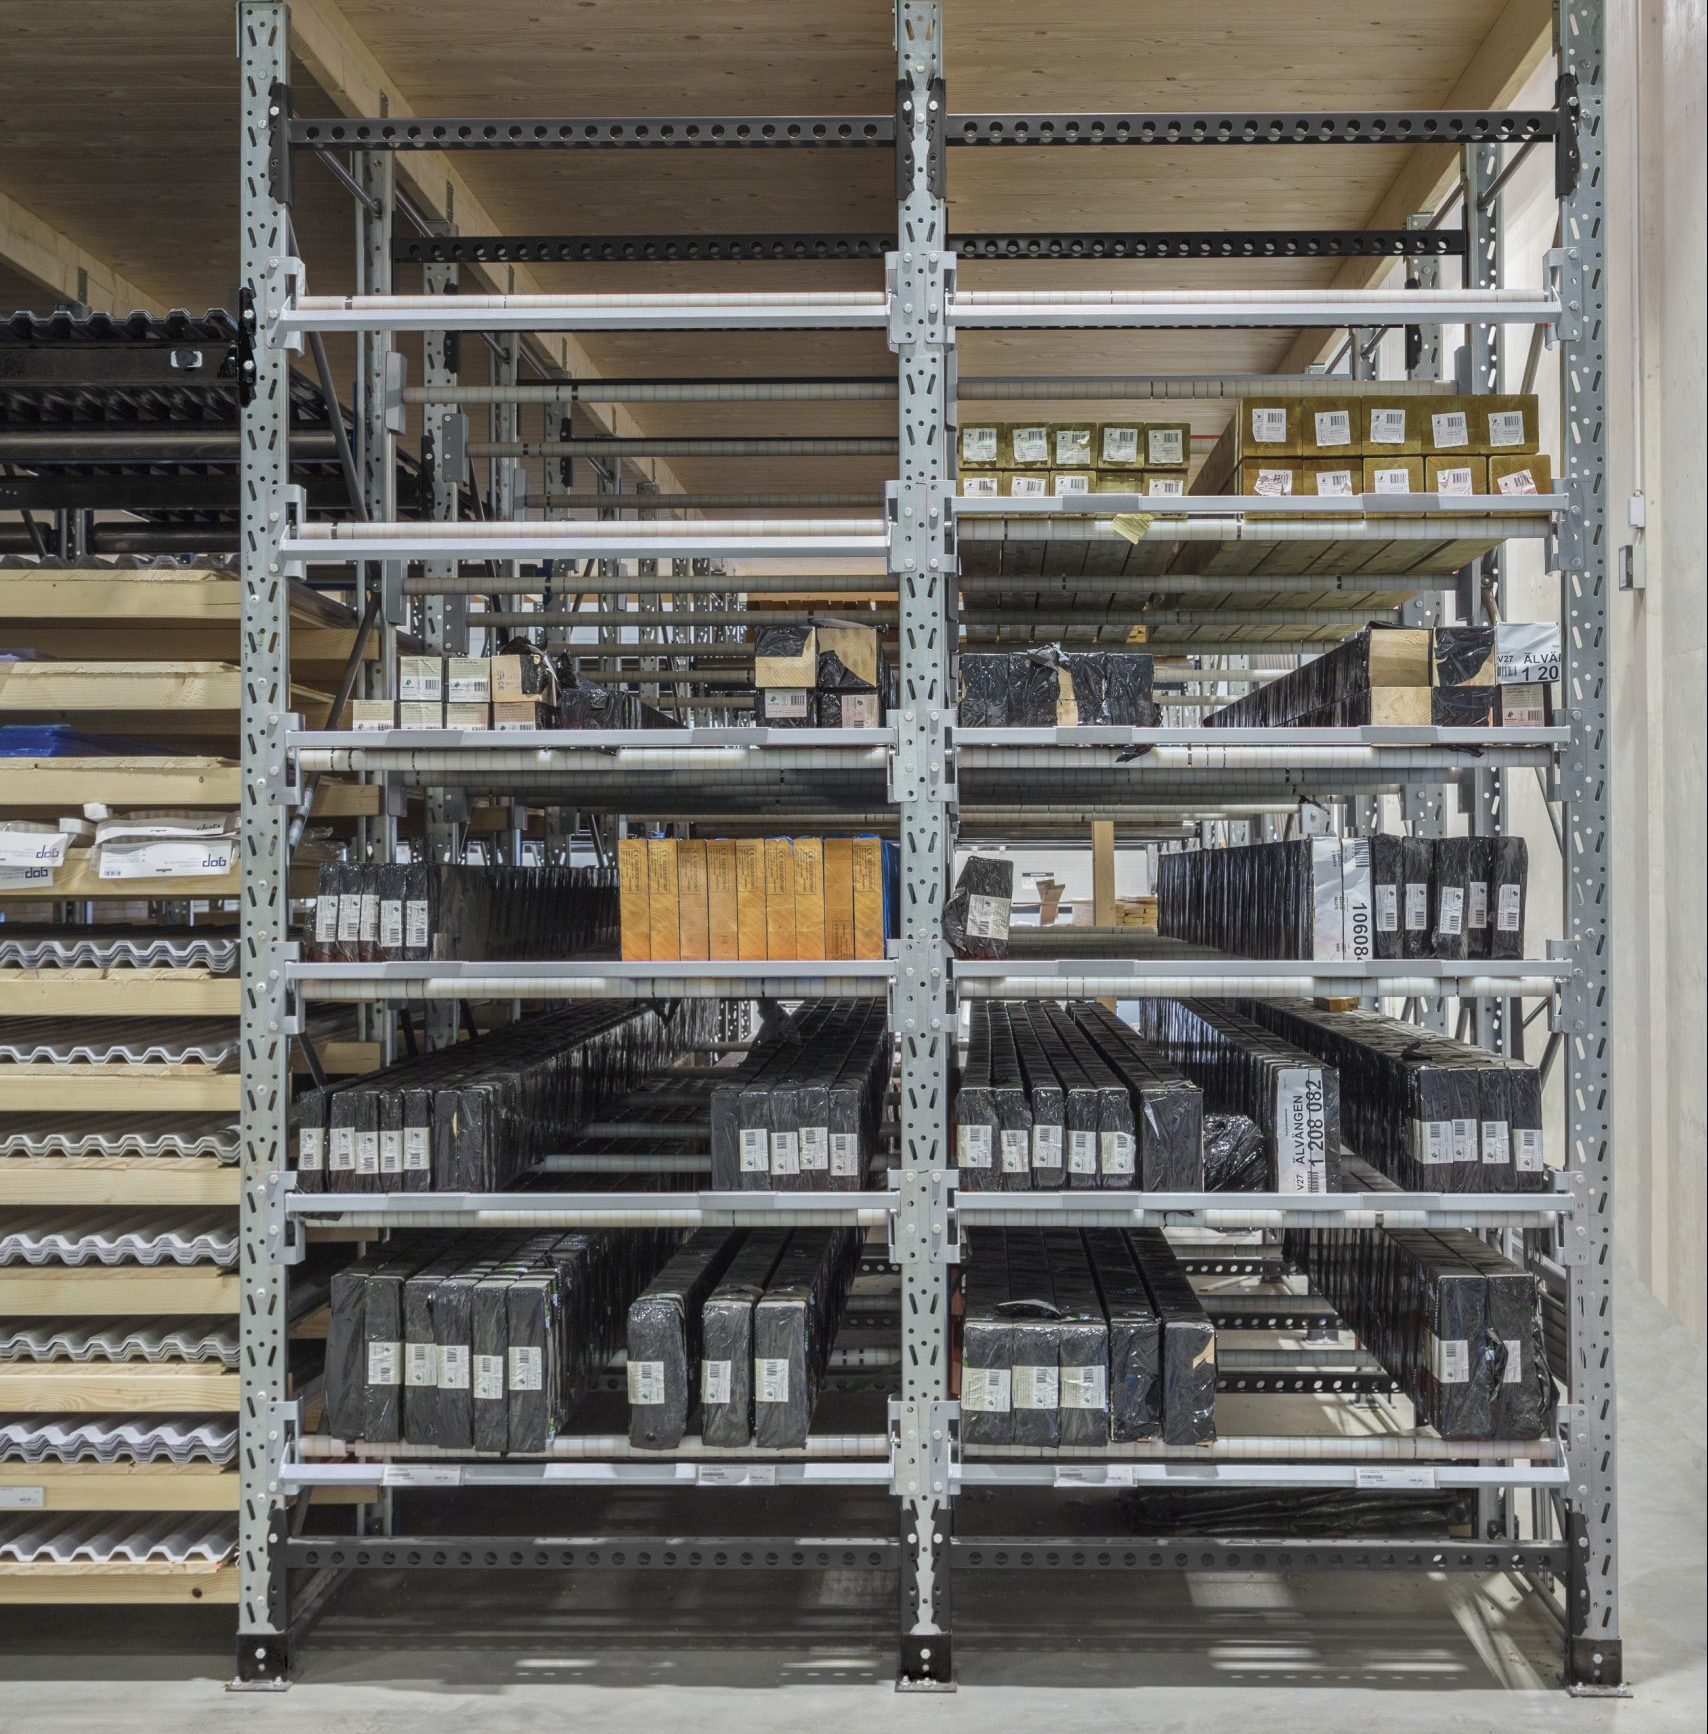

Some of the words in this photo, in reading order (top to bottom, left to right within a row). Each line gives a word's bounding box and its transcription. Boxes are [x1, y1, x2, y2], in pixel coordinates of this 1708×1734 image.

[1498, 655, 1513, 663] V27
[1522, 667, 1529, 681] 1
[1538, 666, 1560, 680] 20
[1305, 1079, 1323, 1113] 082
[1293, 1096, 1305, 1164] ÄLVÄNGEN
[1307, 1119, 1324, 1151] 208
[1308, 1158, 1325, 1167] 1
